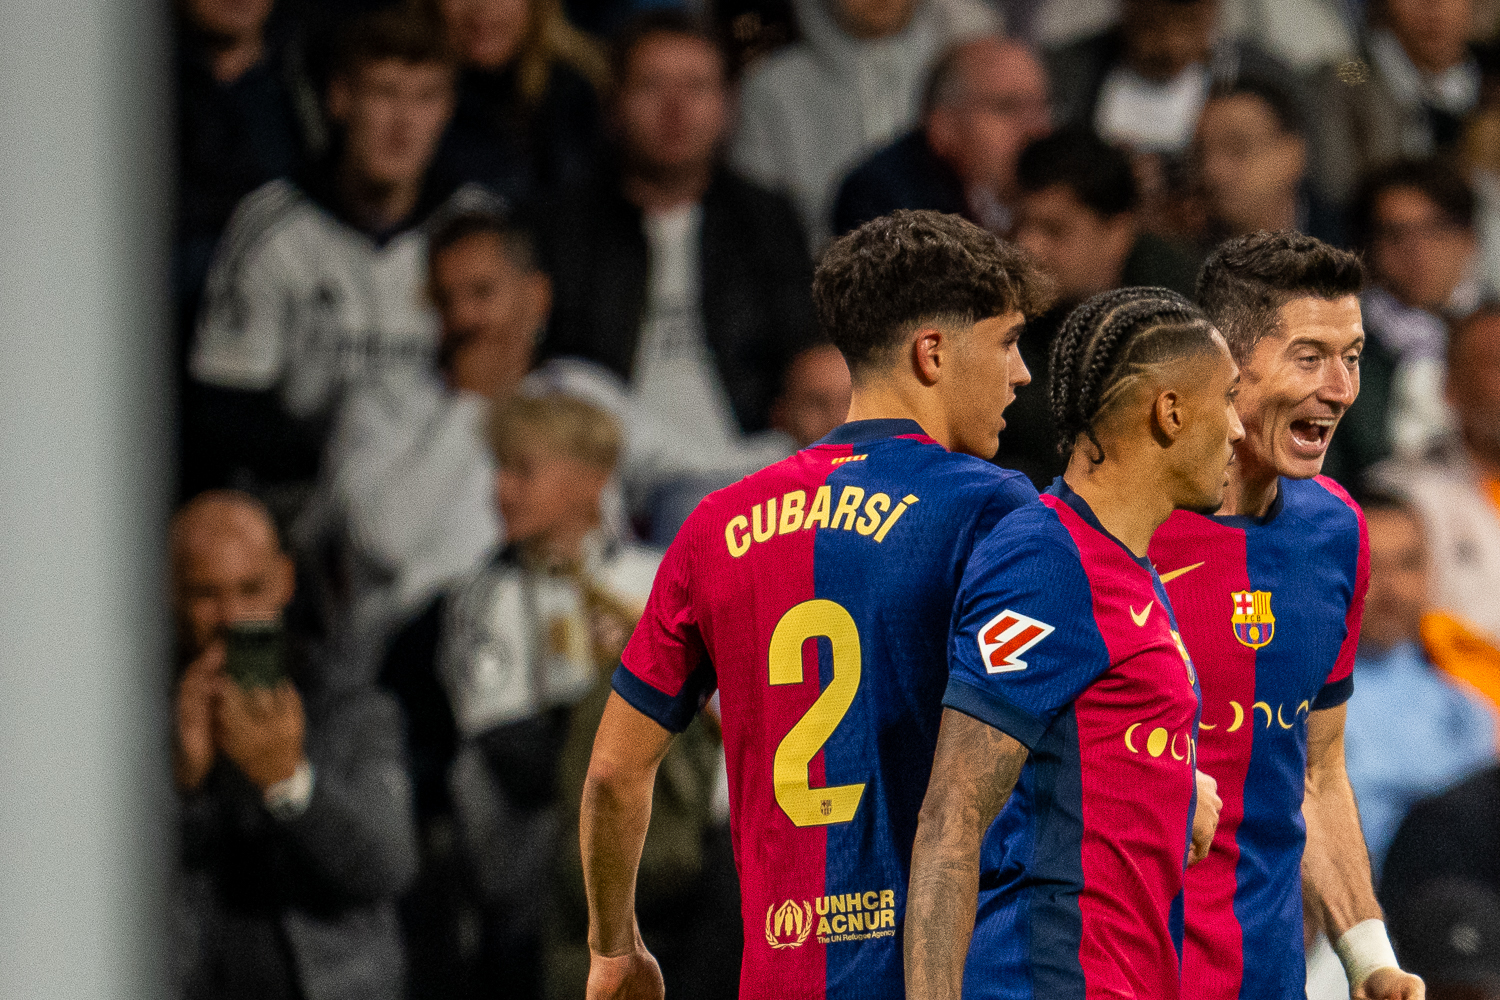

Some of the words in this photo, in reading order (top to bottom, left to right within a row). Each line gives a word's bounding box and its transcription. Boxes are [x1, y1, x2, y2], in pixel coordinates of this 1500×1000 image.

[725, 485, 920, 558] CUBARSÍ
[768, 599, 866, 828] 2
[815, 889, 895, 916] UNHCR
[816, 909, 896, 936] ACNUR
[831, 934, 842, 942] UN
